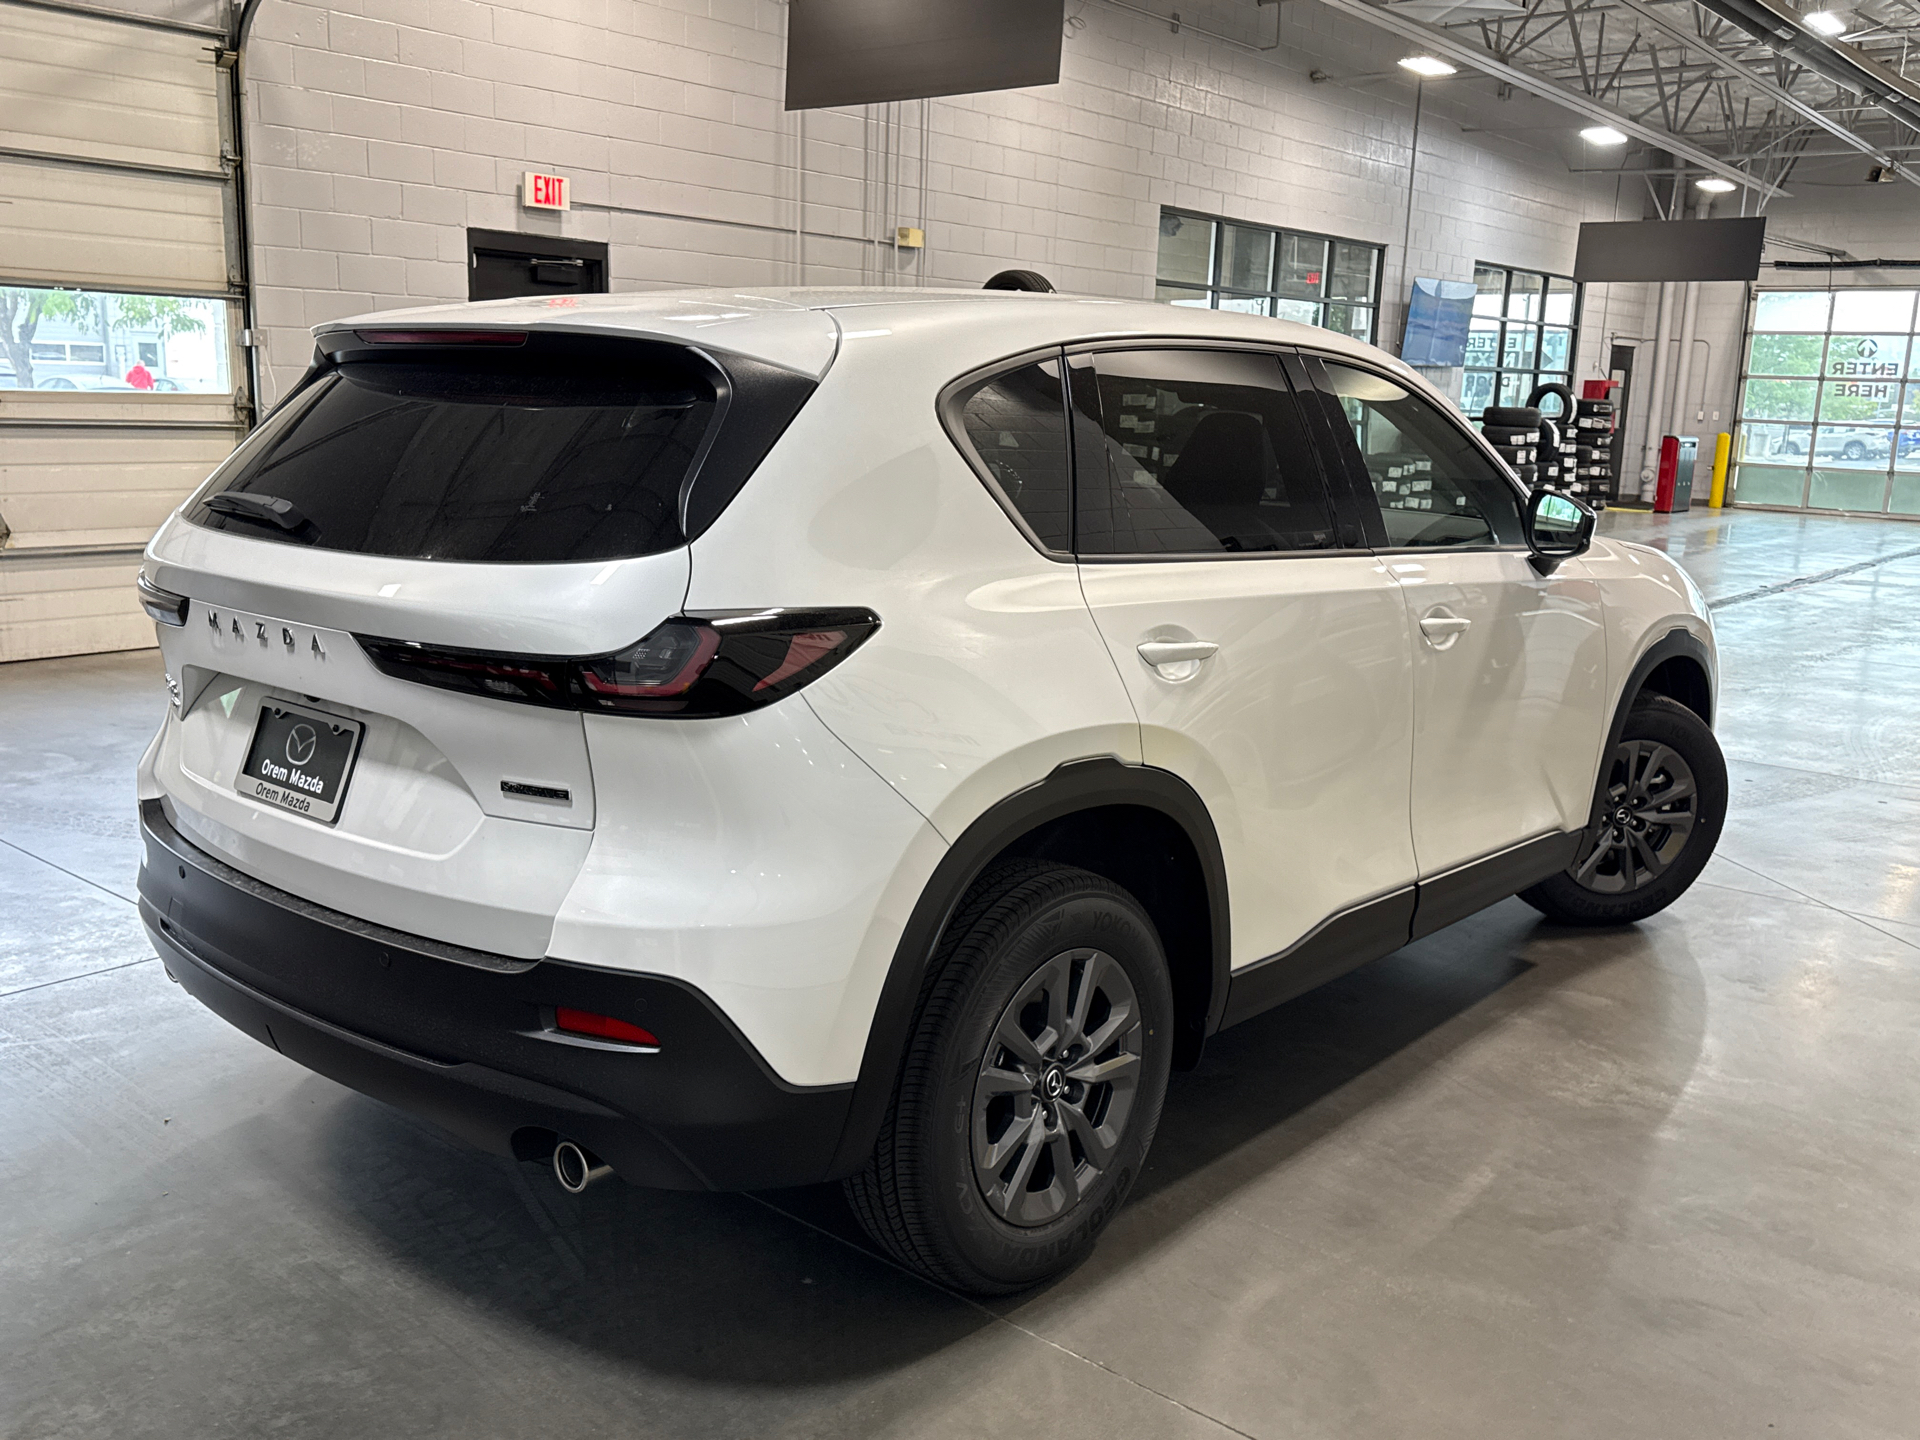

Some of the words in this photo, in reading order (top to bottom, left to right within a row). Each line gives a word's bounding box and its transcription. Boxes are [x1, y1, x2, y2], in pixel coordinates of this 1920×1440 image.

[534, 175, 564, 207] EXIT
[208, 609, 326, 655] MAZDA
[261, 758, 288, 783] Orem
[289, 764, 324, 794] Mazda
[255, 781, 279, 801] Orem
[280, 788, 311, 813] Mazda
